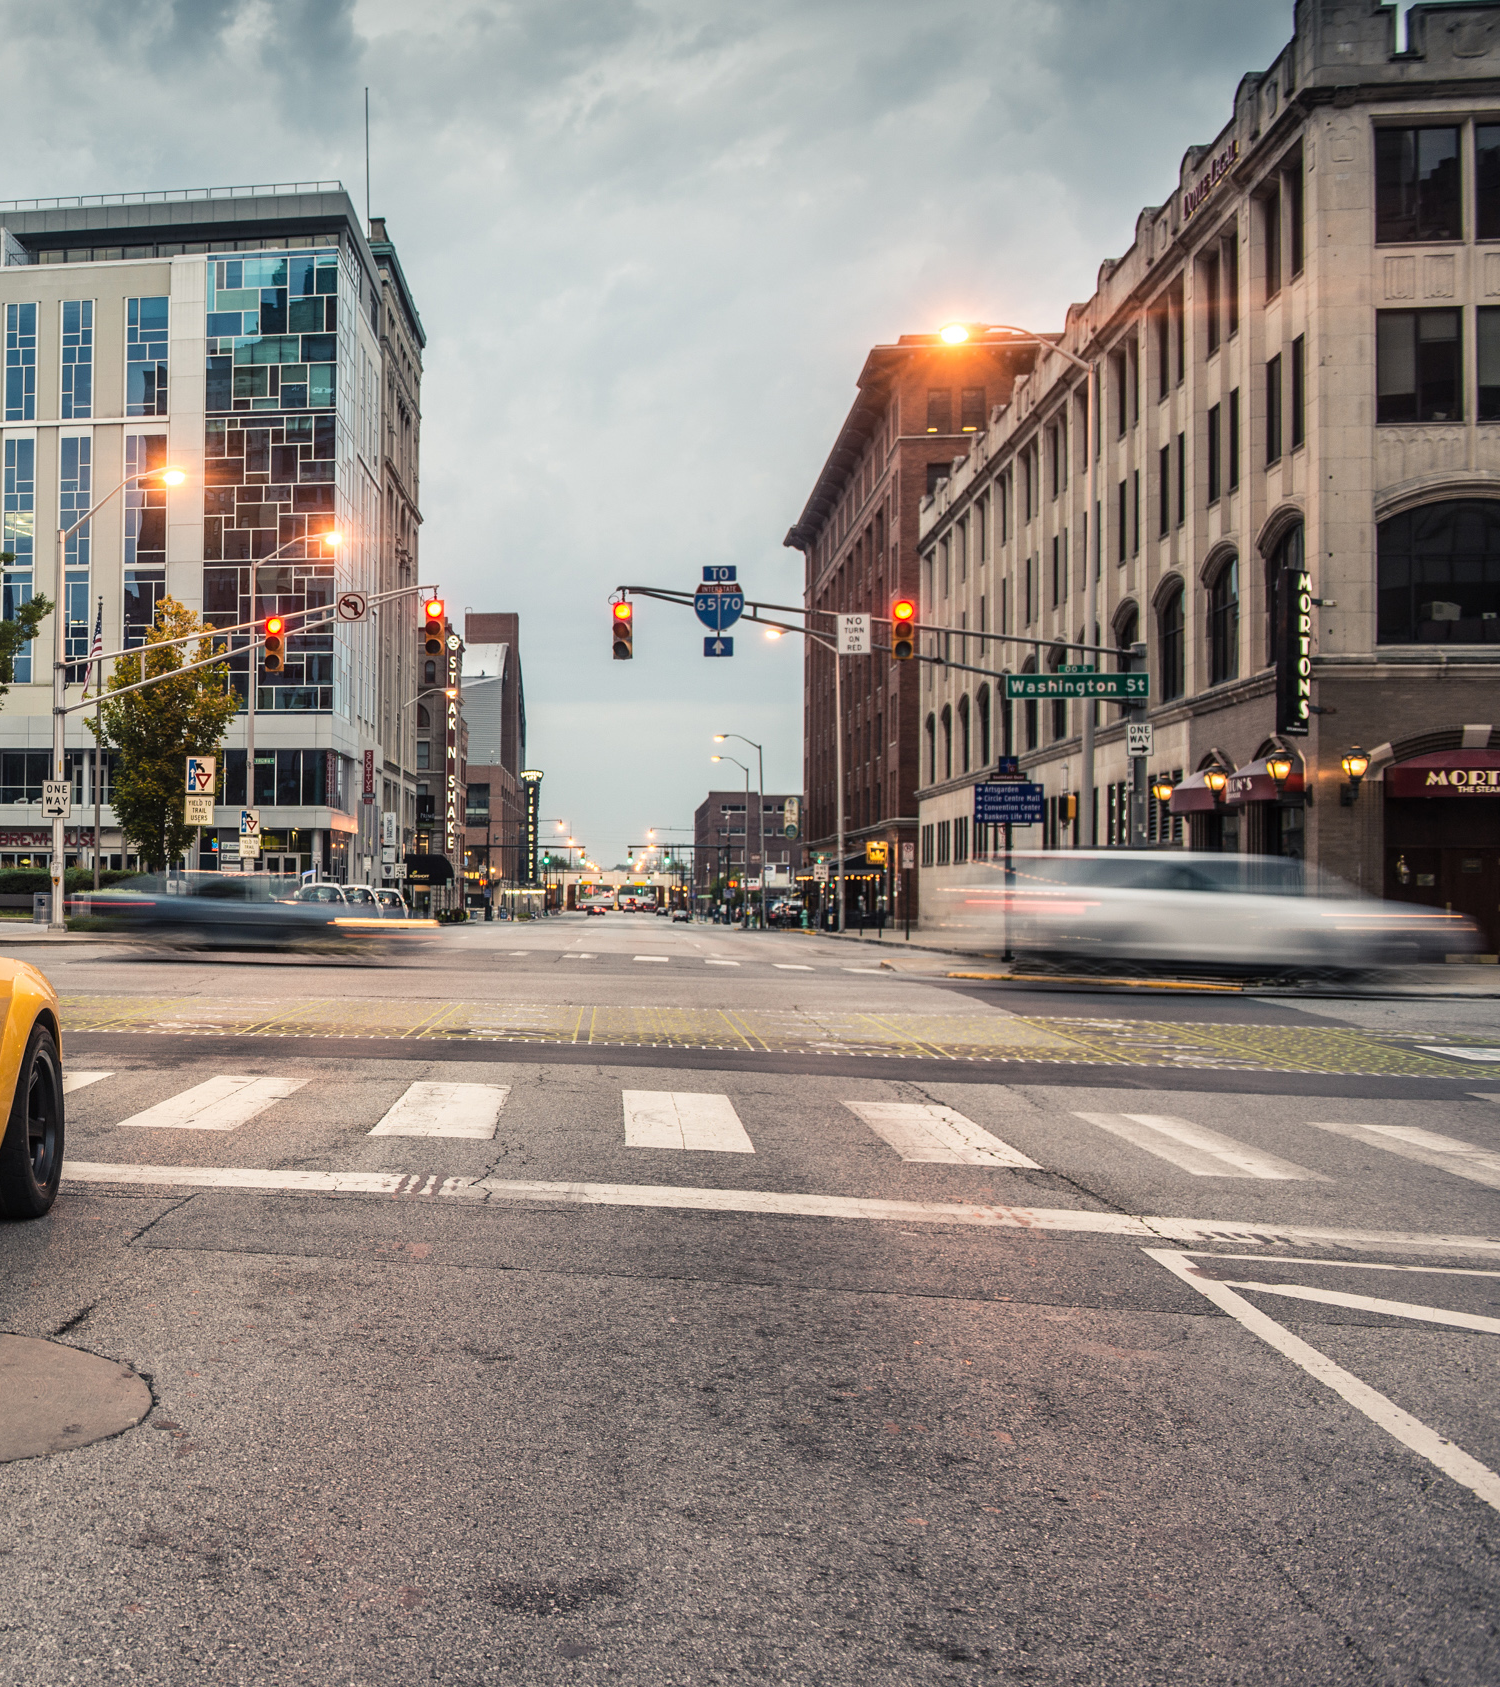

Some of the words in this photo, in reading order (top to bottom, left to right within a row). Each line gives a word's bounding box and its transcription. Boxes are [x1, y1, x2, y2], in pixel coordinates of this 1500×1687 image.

[710, 567, 729, 580] TO
[701, 585, 737, 593] INTERSTATE
[697, 598, 716, 611] 65
[722, 597, 741, 610] 70
[846, 617, 862, 625] NO
[849, 635, 860, 643] ON
[1297, 573, 1312, 719] MORTONS
[1083, 665, 1088, 673] S
[1011, 679, 1117, 696] Washington
[1126, 678, 1145, 692] St
[1130, 726, 1150, 734] ONE
[1130, 735, 1150, 743] WAY
[447, 746, 457, 759] N
[1425, 770, 1500, 785] MORT
[46, 784, 68, 793] ONE
[984, 786, 1019, 794] Artsgarden
[45, 796, 68, 805] WAY
[446, 775, 456, 849] SHAKE
